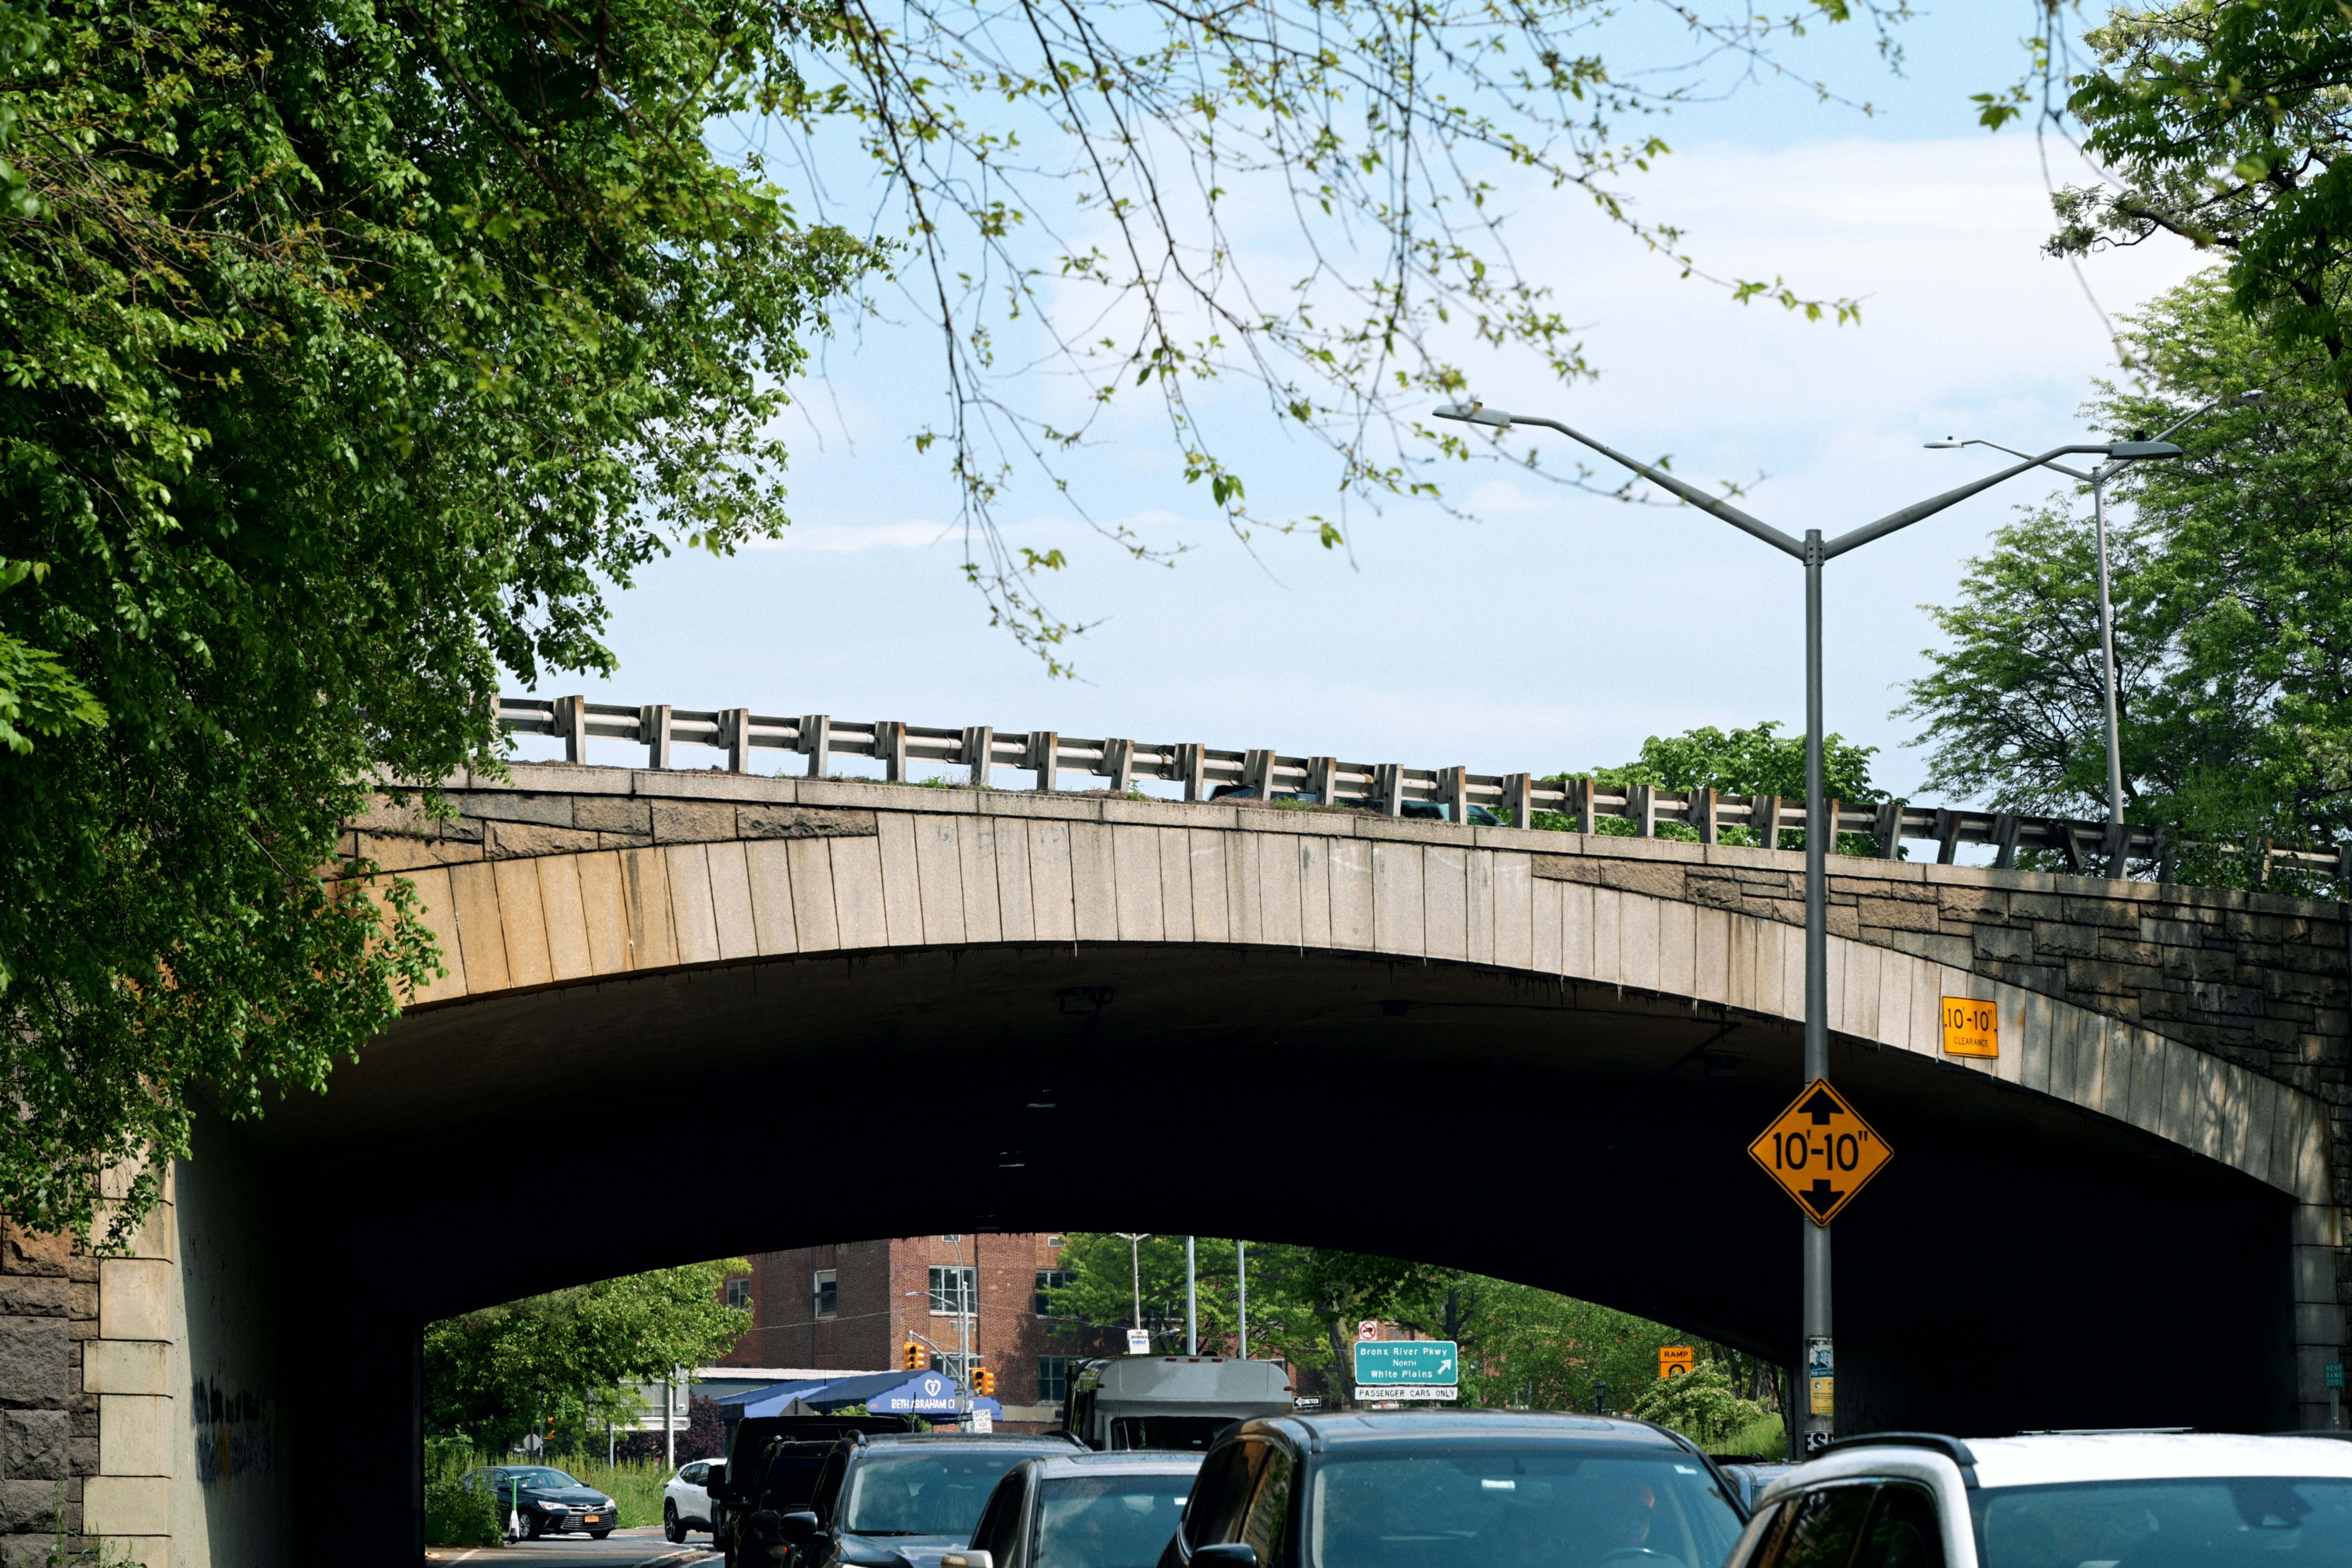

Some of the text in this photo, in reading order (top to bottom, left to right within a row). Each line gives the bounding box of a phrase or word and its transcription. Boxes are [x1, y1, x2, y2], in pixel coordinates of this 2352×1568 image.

[1954, 1037, 1989, 1047] CLEARANCE
[1773, 1130, 1868, 1171] 10'-10"
[1423, 1348, 1447, 1356] Pkwy
[891, 1399, 909, 1409] BETH
[910, 1399, 947, 1409] ABRAHAM
[1804, 1433, 1833, 1455] ES
